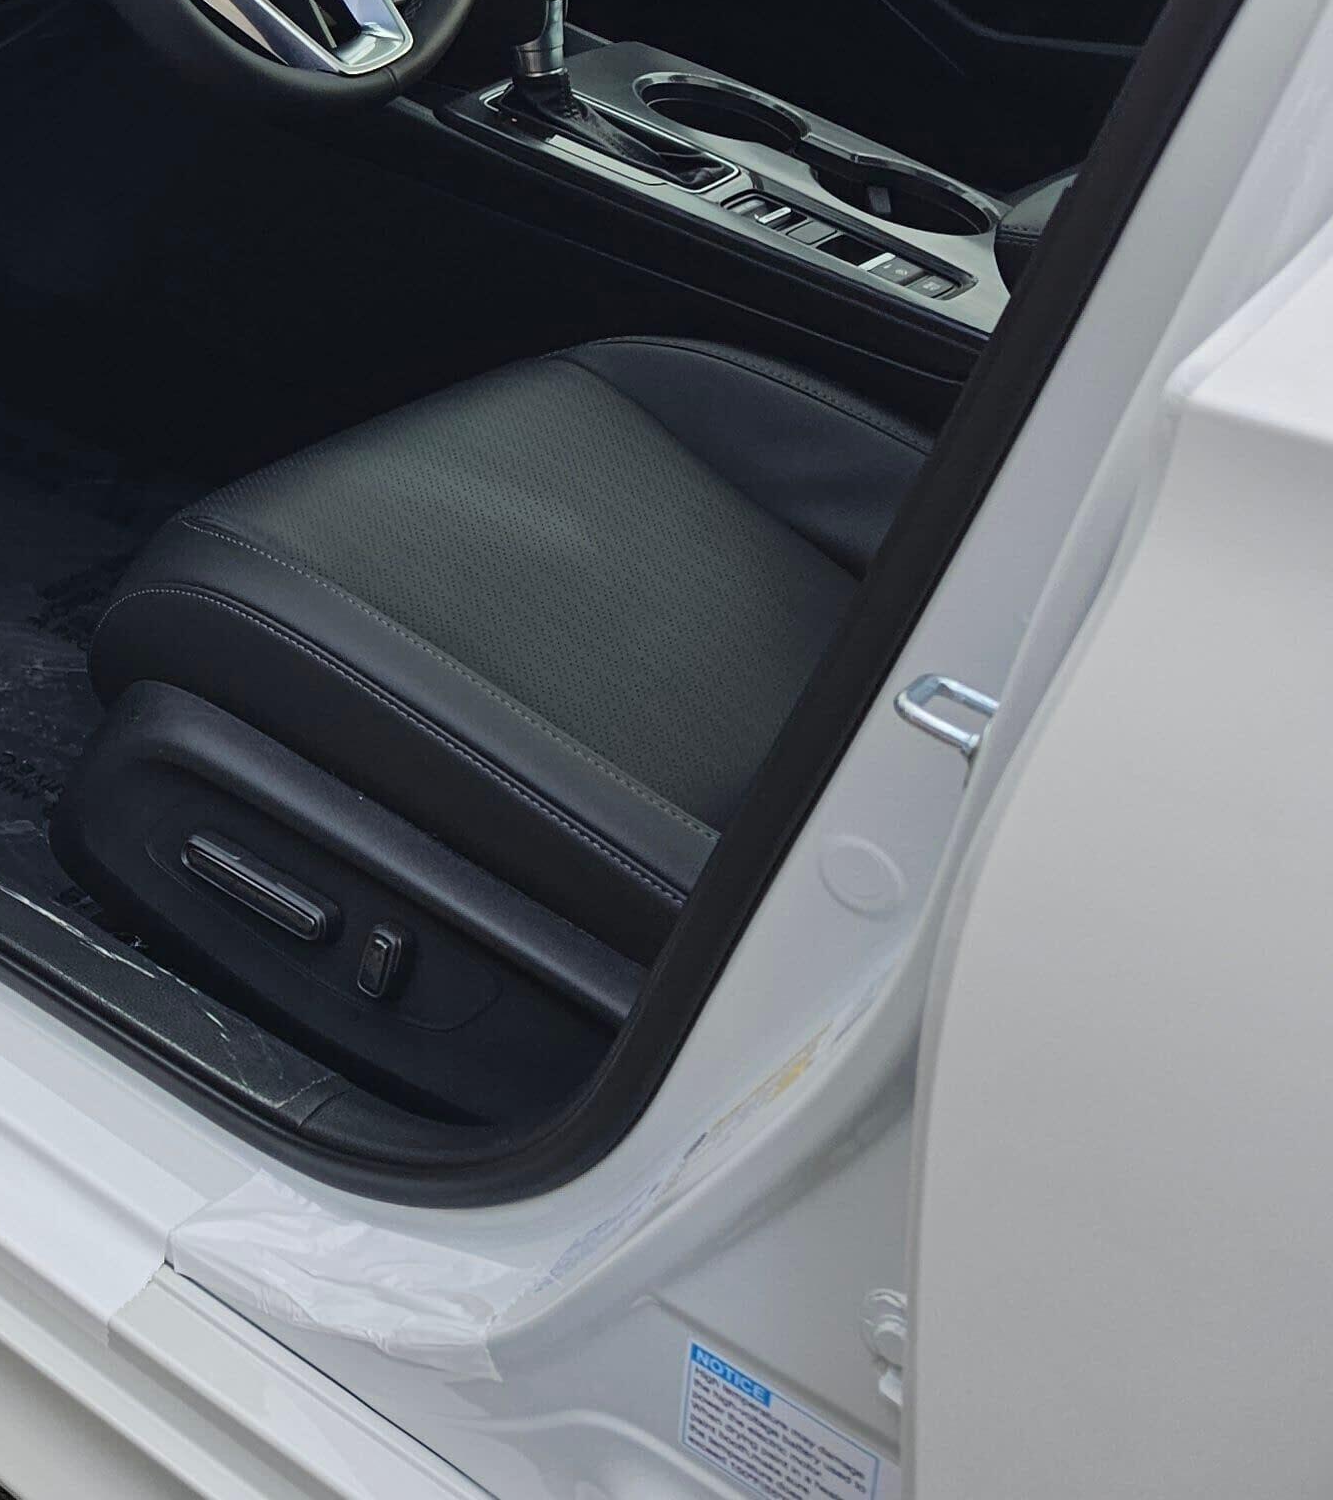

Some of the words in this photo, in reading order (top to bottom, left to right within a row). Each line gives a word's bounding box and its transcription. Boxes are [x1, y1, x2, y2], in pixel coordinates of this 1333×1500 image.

[694, 1348, 767, 1403] NOTICE
[722, 1383, 787, 1431] temperature
[817, 1443, 864, 1481] damage
[747, 1424, 785, 1456] electric
[782, 1434, 819, 1465] battery
[707, 1435, 772, 1484] temperature
